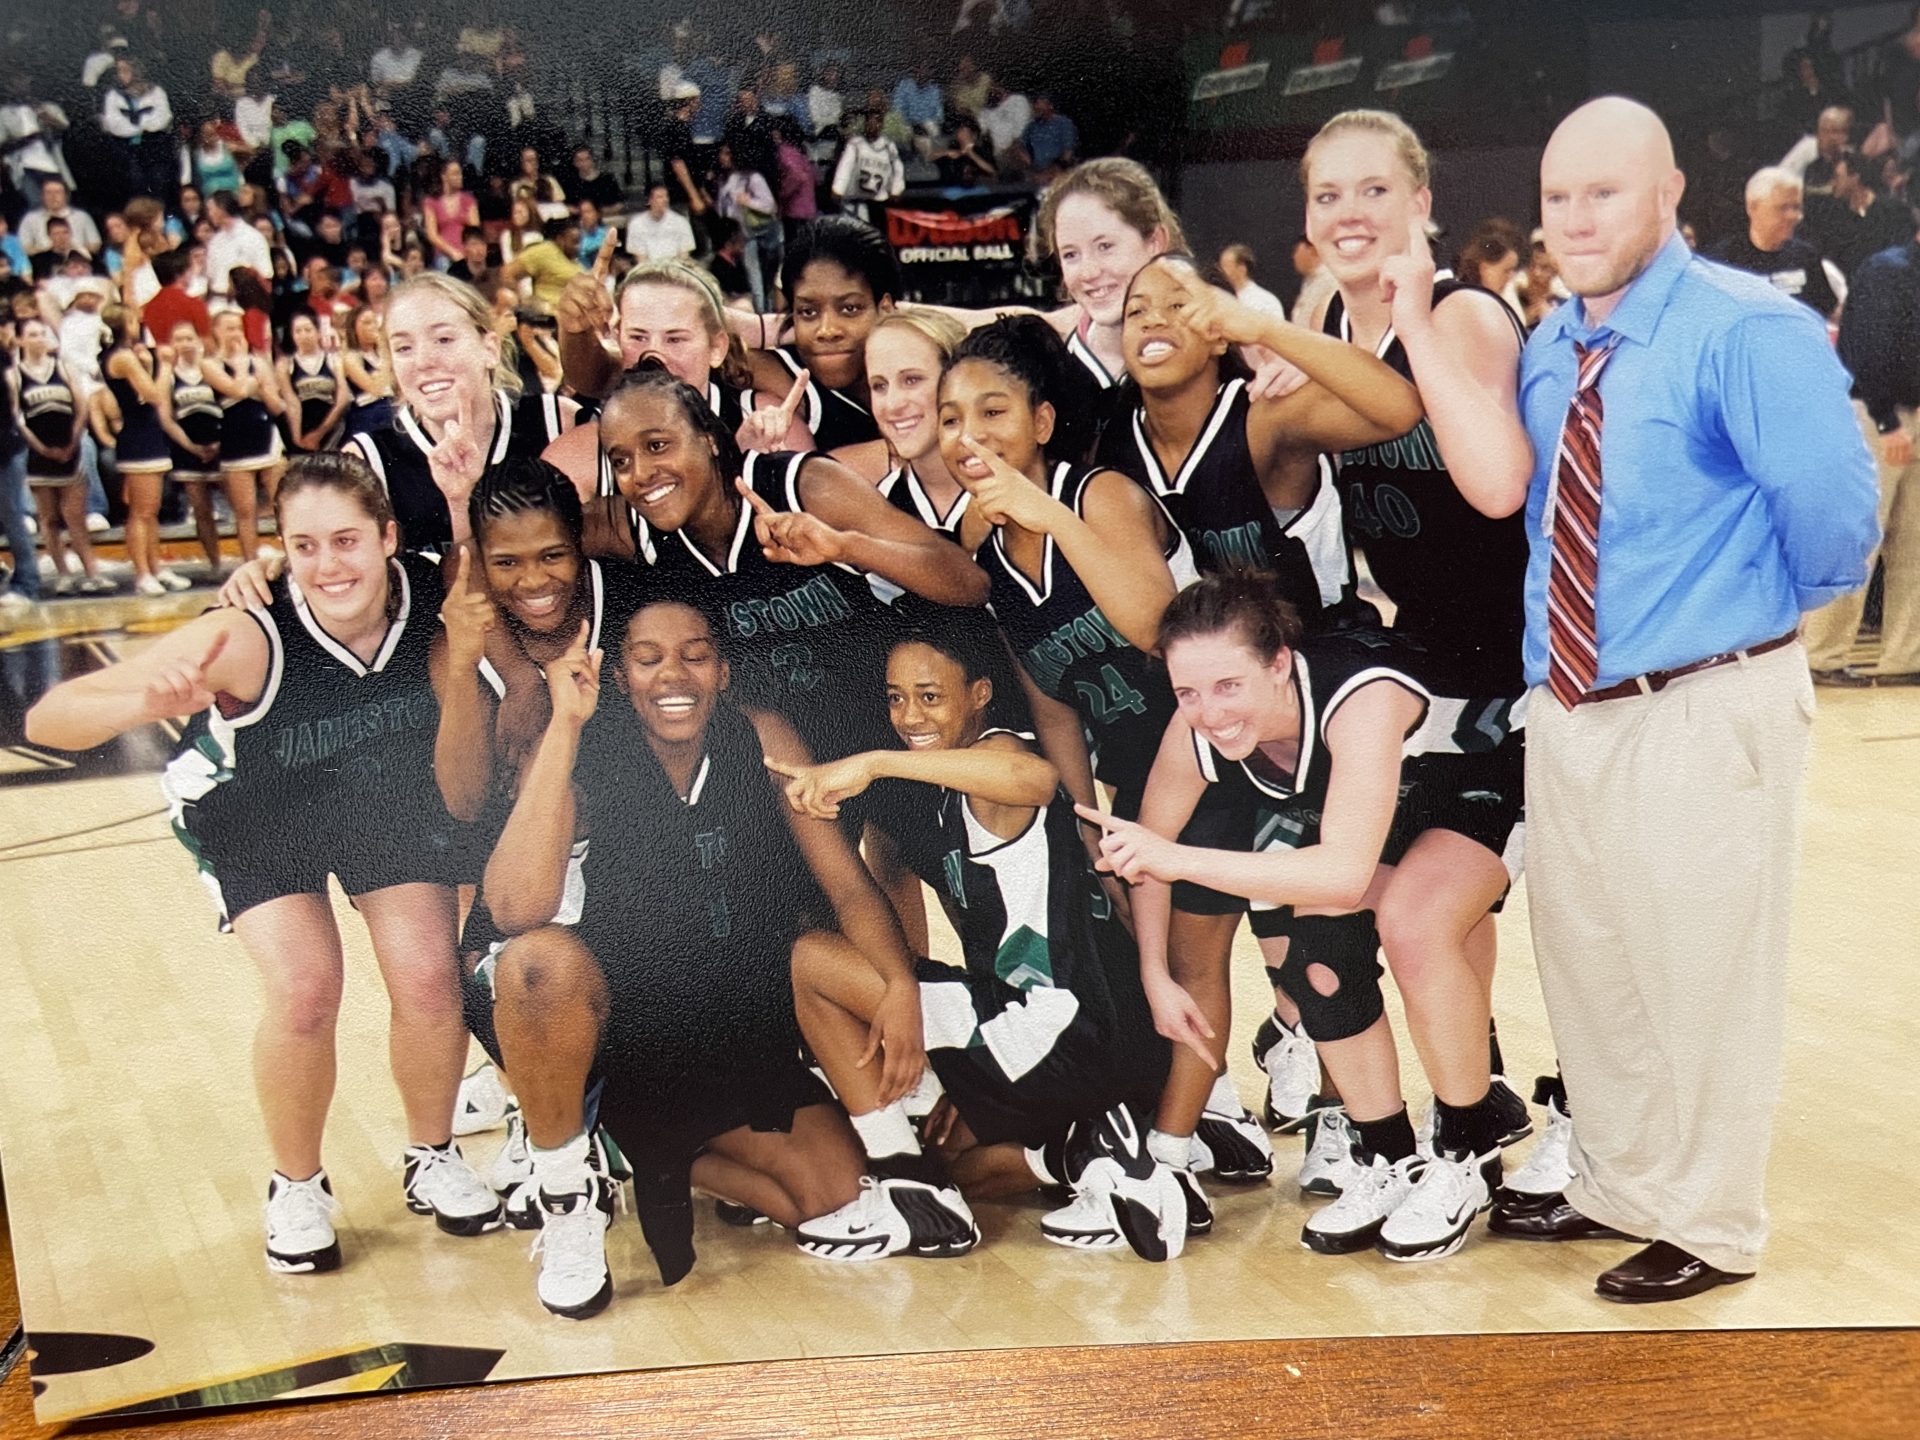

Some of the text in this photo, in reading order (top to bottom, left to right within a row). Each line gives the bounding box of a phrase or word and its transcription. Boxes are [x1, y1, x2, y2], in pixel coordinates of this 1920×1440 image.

[900, 243, 1014, 264] OFFICIAL BALL
[1349, 482, 1421, 539] 40
[722, 573, 853, 638] STOWN
[1073, 663, 1148, 725] 24
